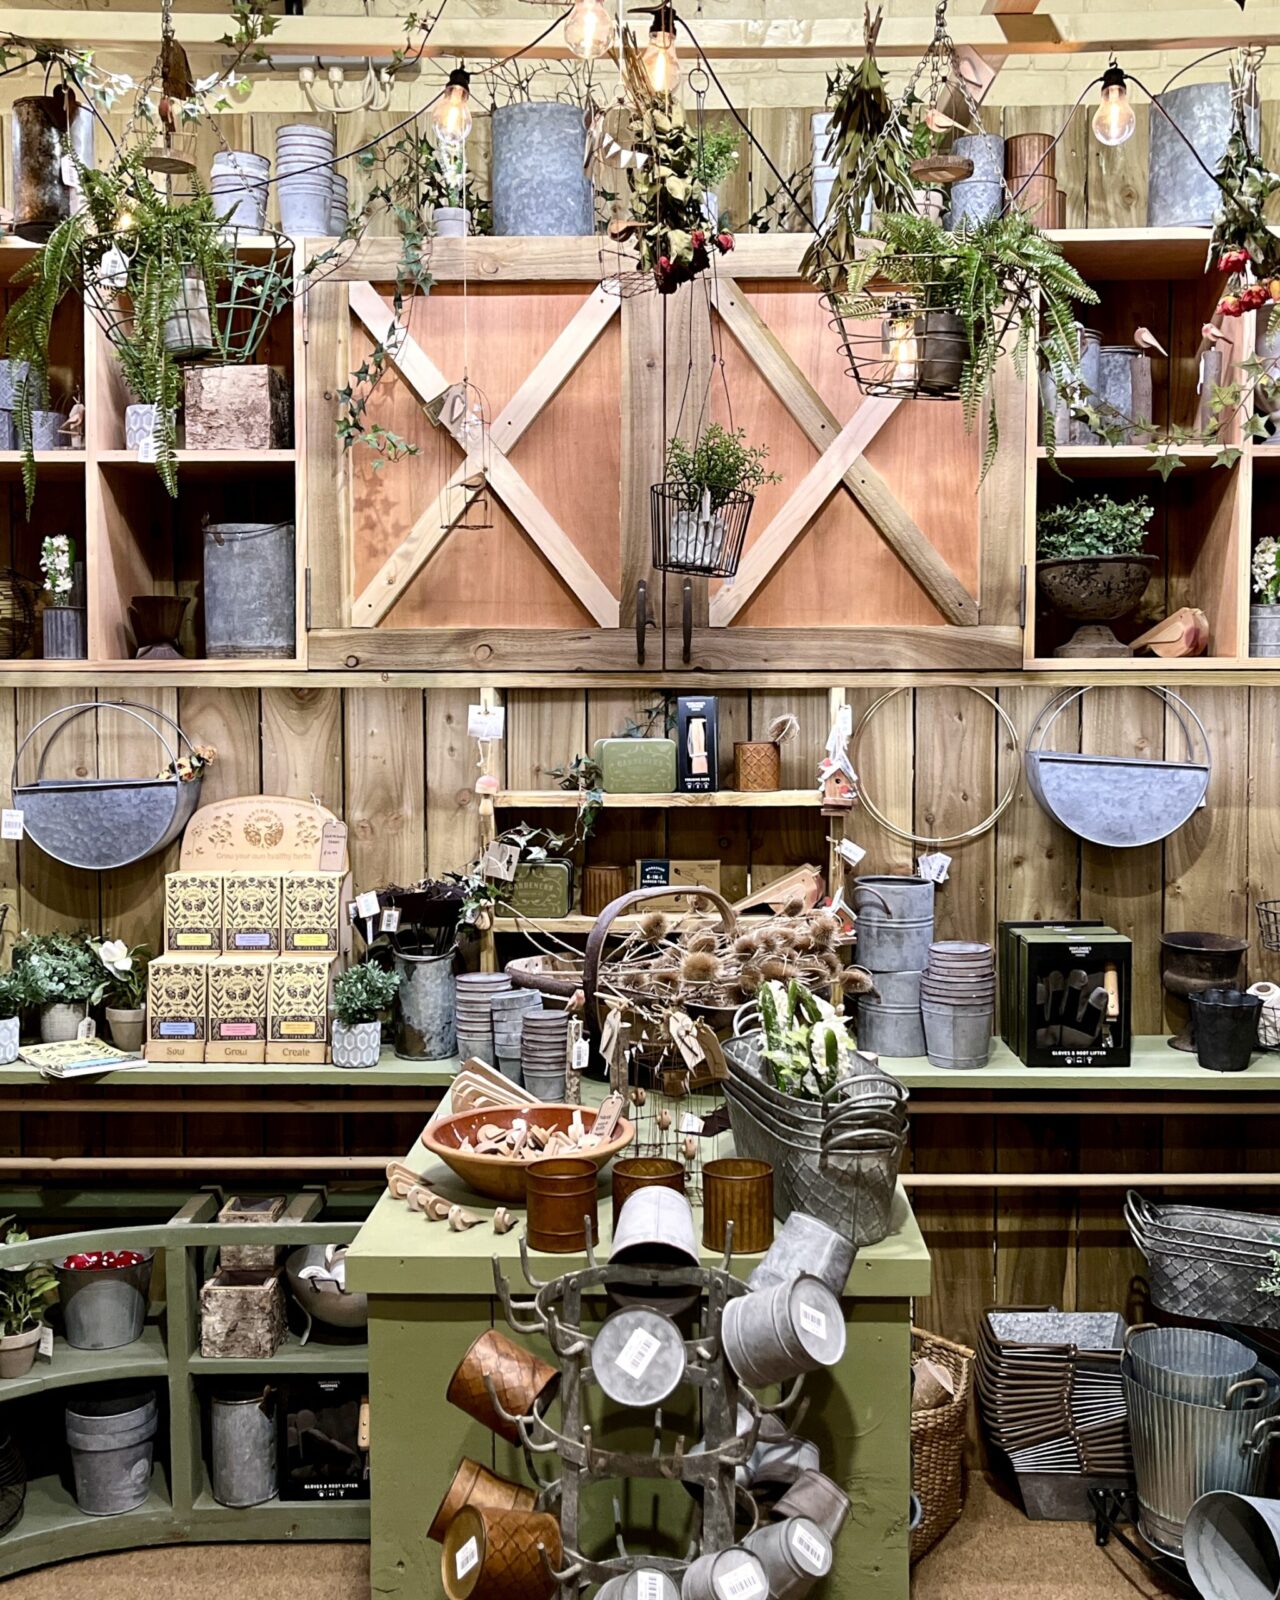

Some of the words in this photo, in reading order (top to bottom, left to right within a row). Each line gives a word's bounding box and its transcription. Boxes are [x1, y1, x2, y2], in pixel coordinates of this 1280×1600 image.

[166, 1046, 185, 1056] Sow
[224, 1047, 248, 1056] Grow
[282, 1047, 311, 1057] Create
